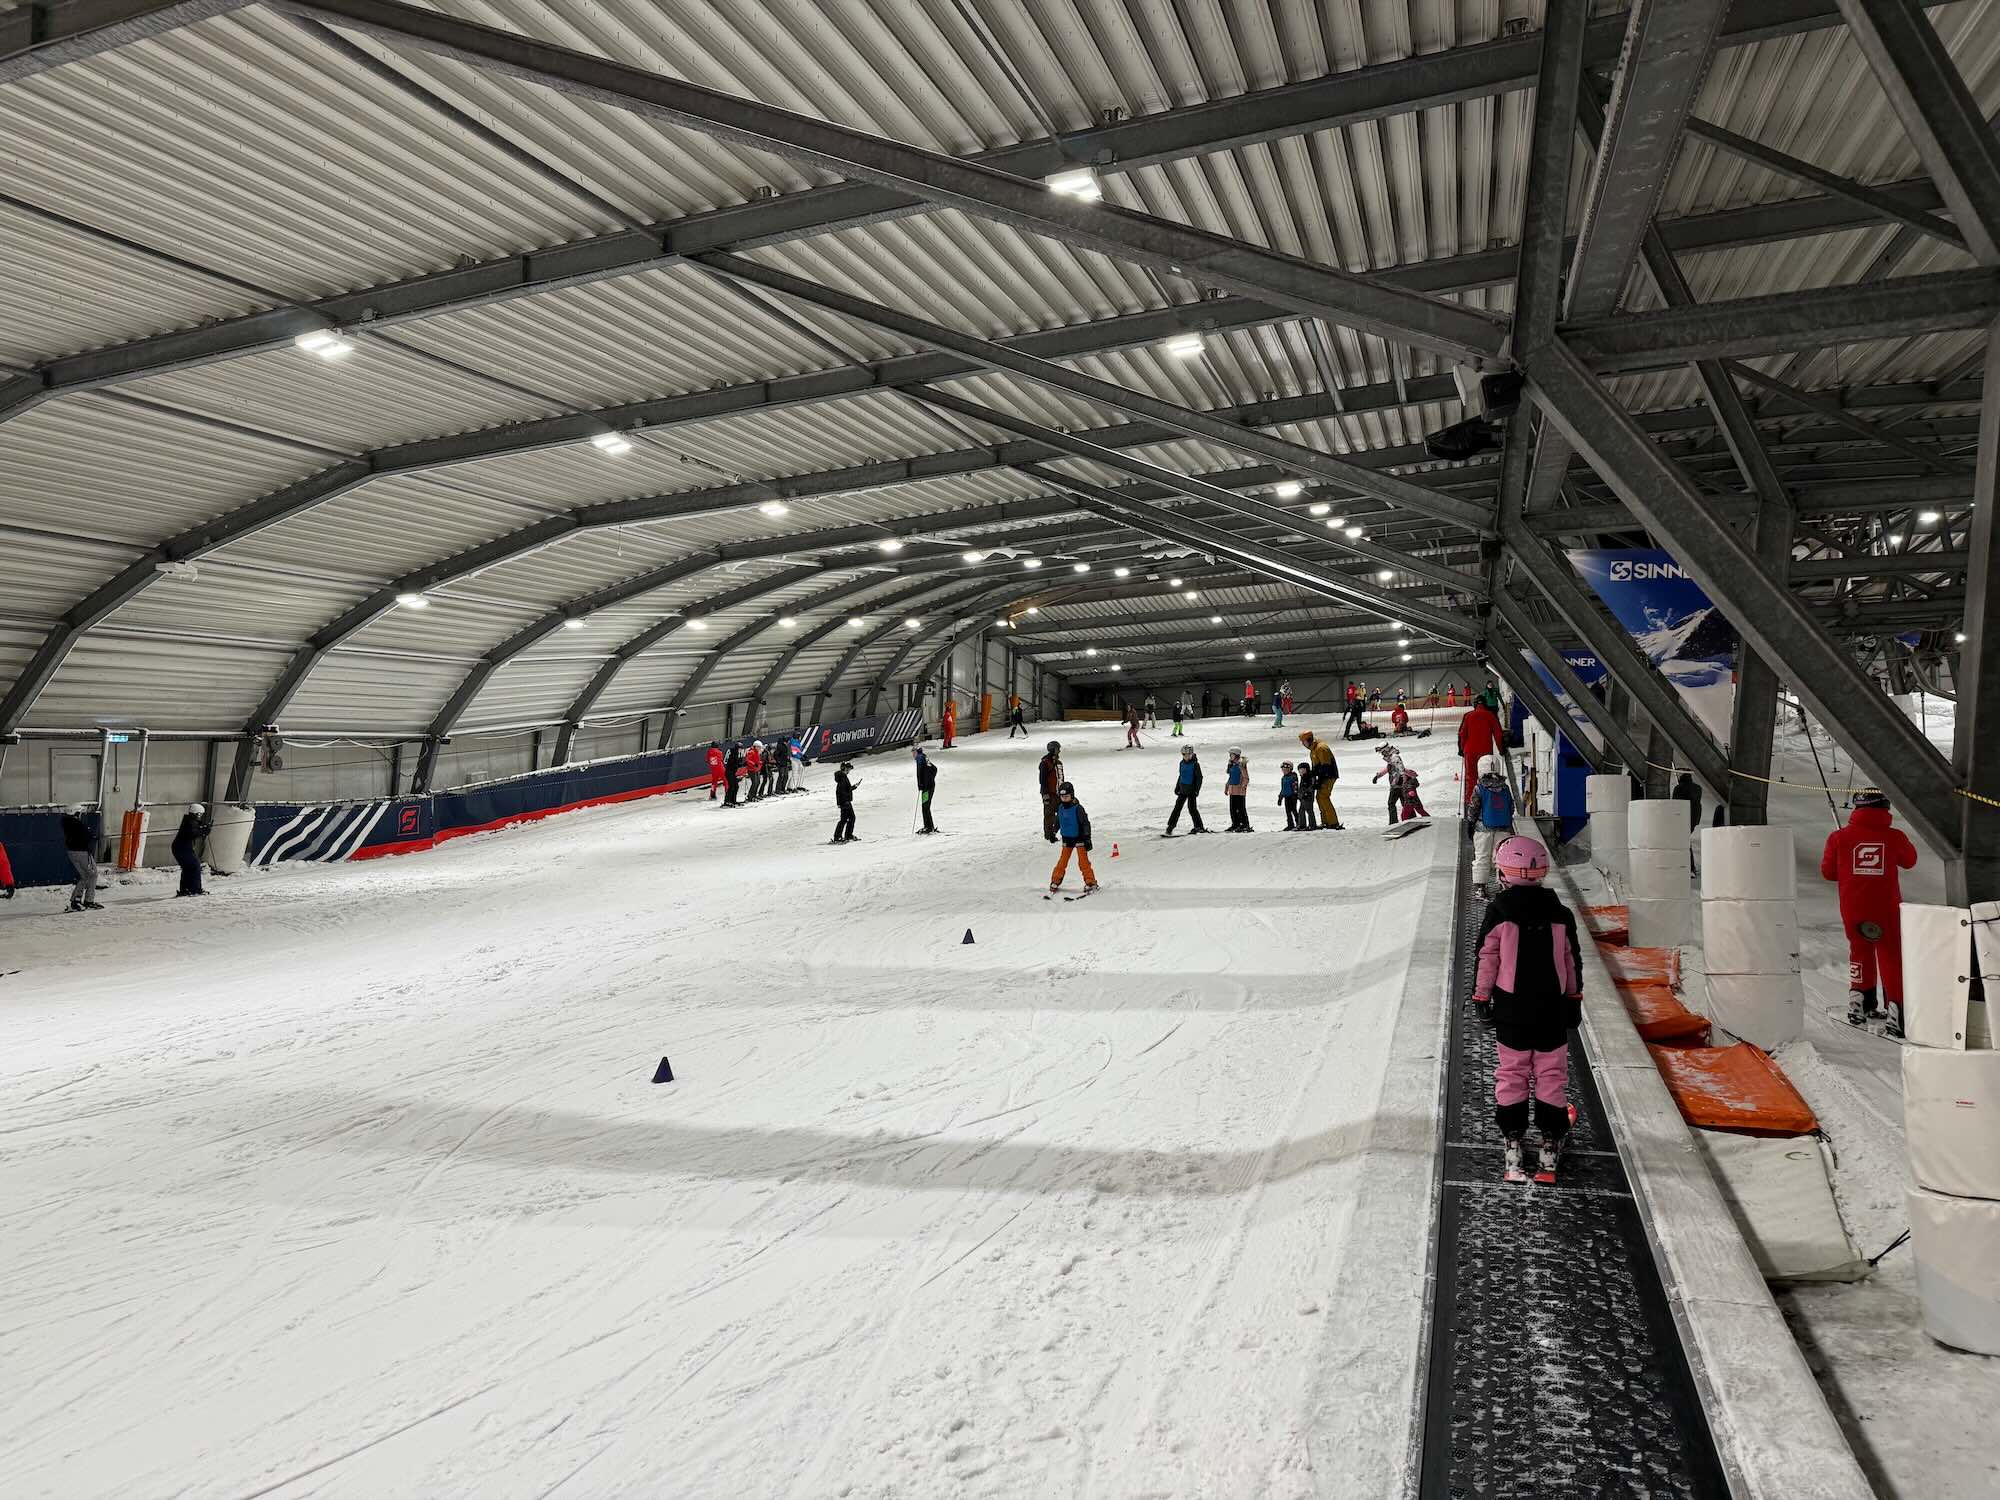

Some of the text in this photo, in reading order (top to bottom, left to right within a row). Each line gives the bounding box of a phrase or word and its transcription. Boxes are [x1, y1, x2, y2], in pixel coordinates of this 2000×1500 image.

[1633, 563, 1692, 579] SINN
[1564, 657, 1596, 667] NNER
[832, 727, 875, 744] SNOWWORLD
